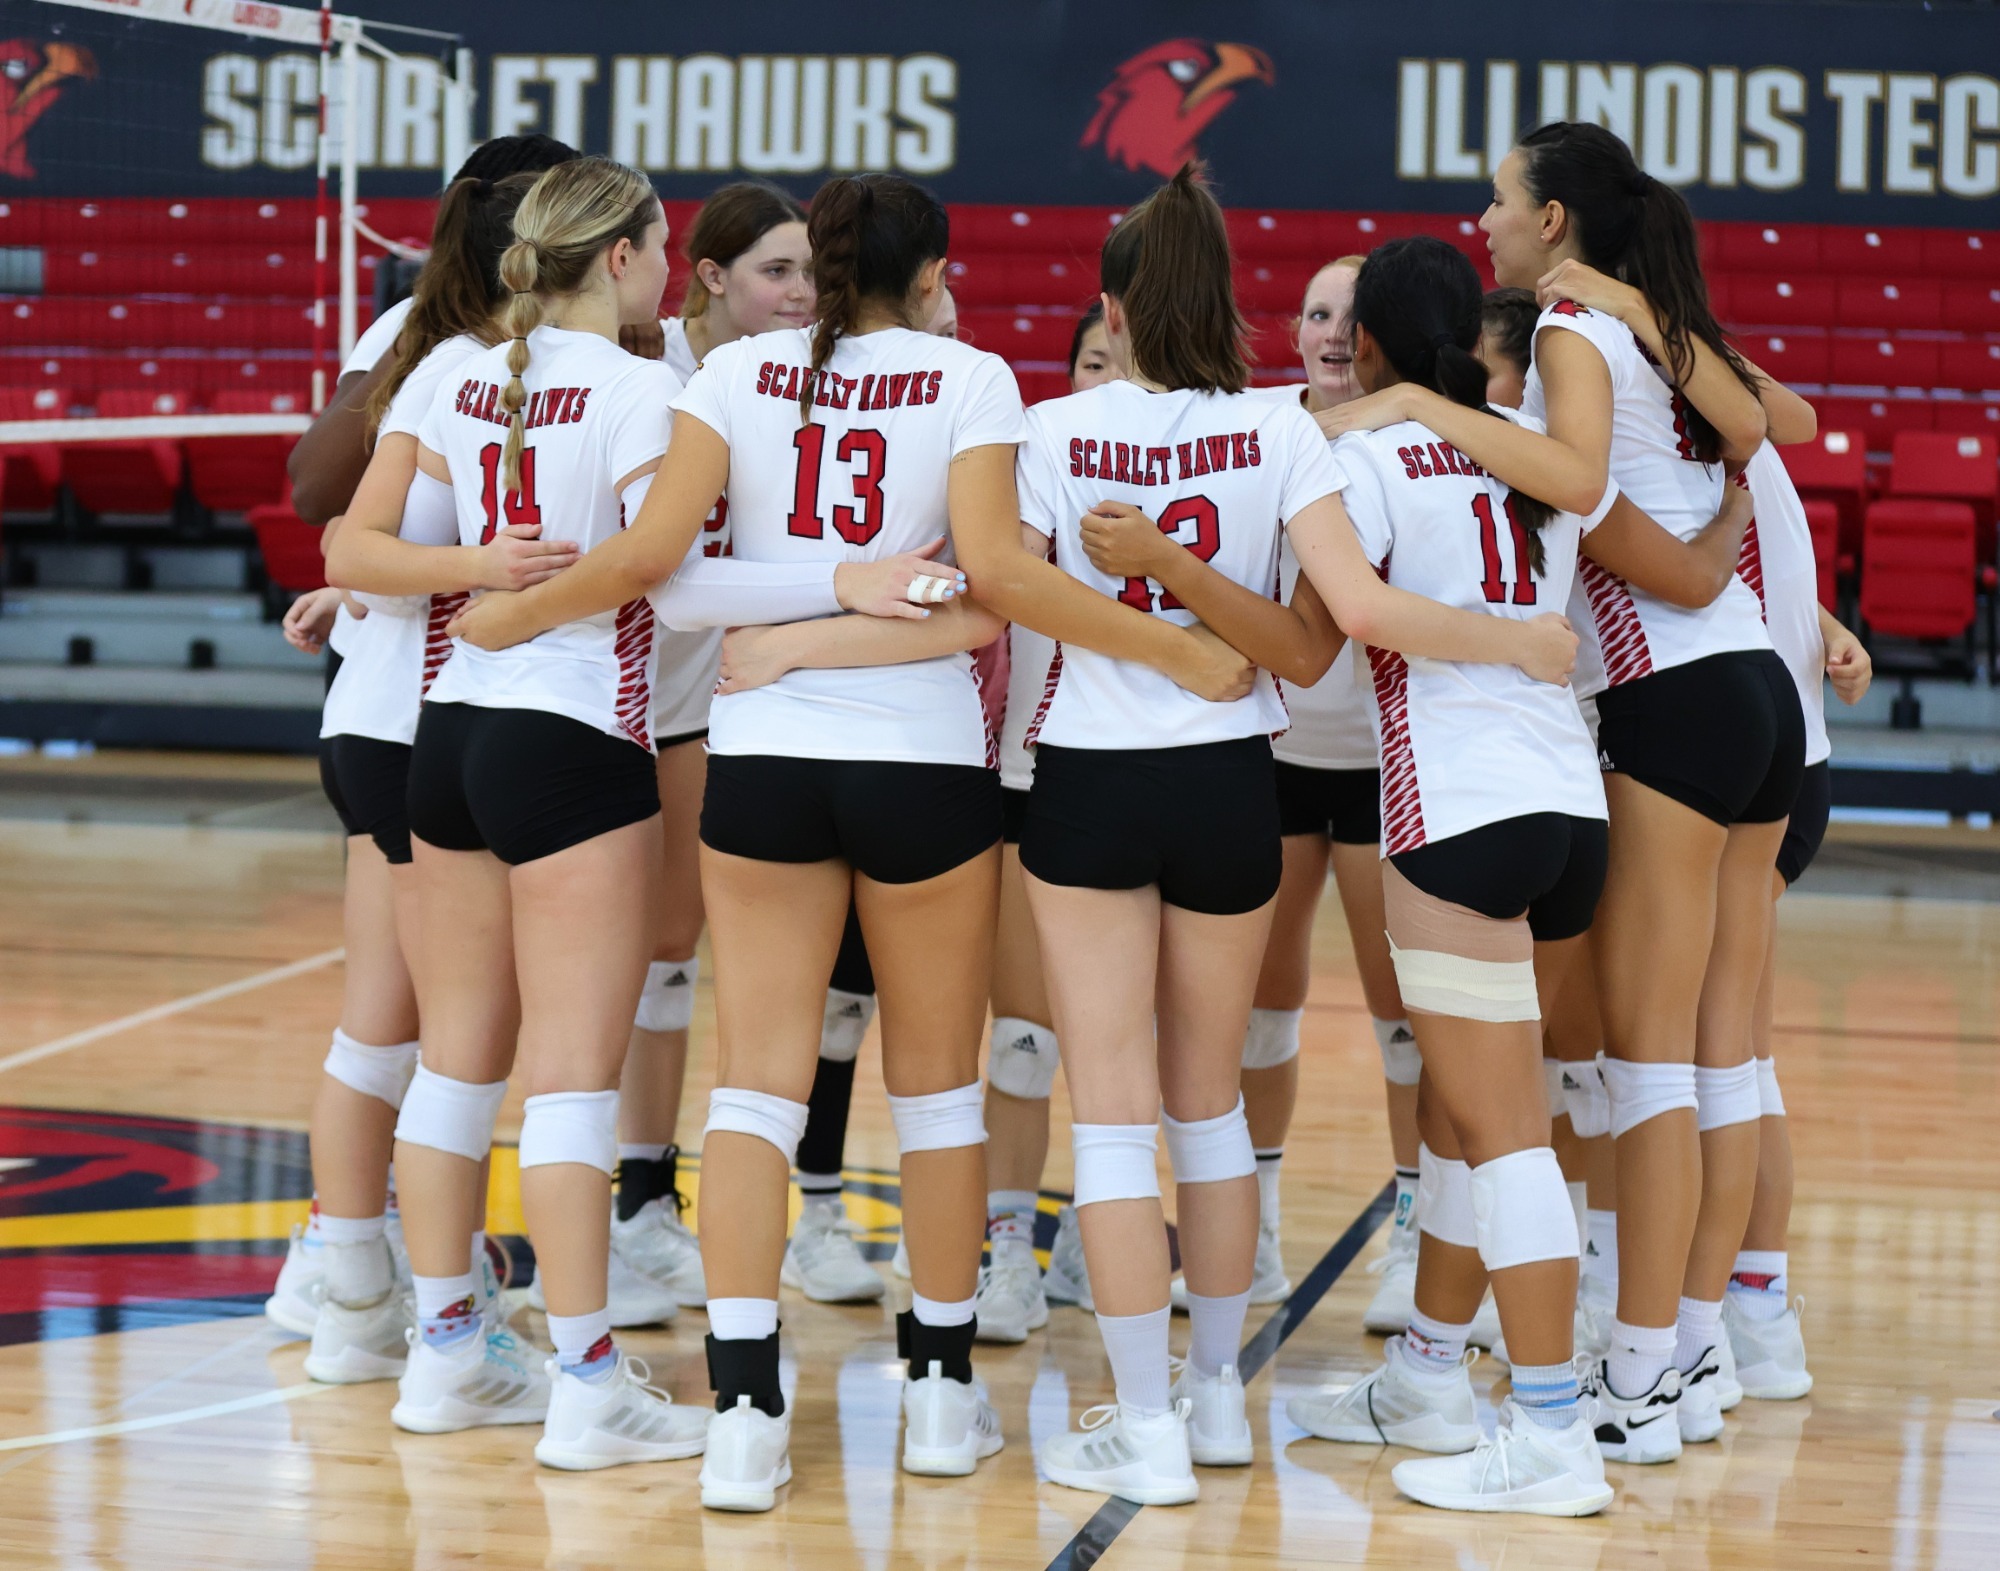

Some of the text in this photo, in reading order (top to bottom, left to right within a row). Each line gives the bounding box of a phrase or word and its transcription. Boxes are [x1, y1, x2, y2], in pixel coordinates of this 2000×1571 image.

[200, 52, 957, 175] SCARET HAWKS
[858, 370, 943, 411] HAWKS
[479, 441, 542, 546] 14
[787, 422, 887, 546] 13
[1069, 428, 1262, 486] SCARLET HAWKS
[1471, 492, 1537, 606] 11
